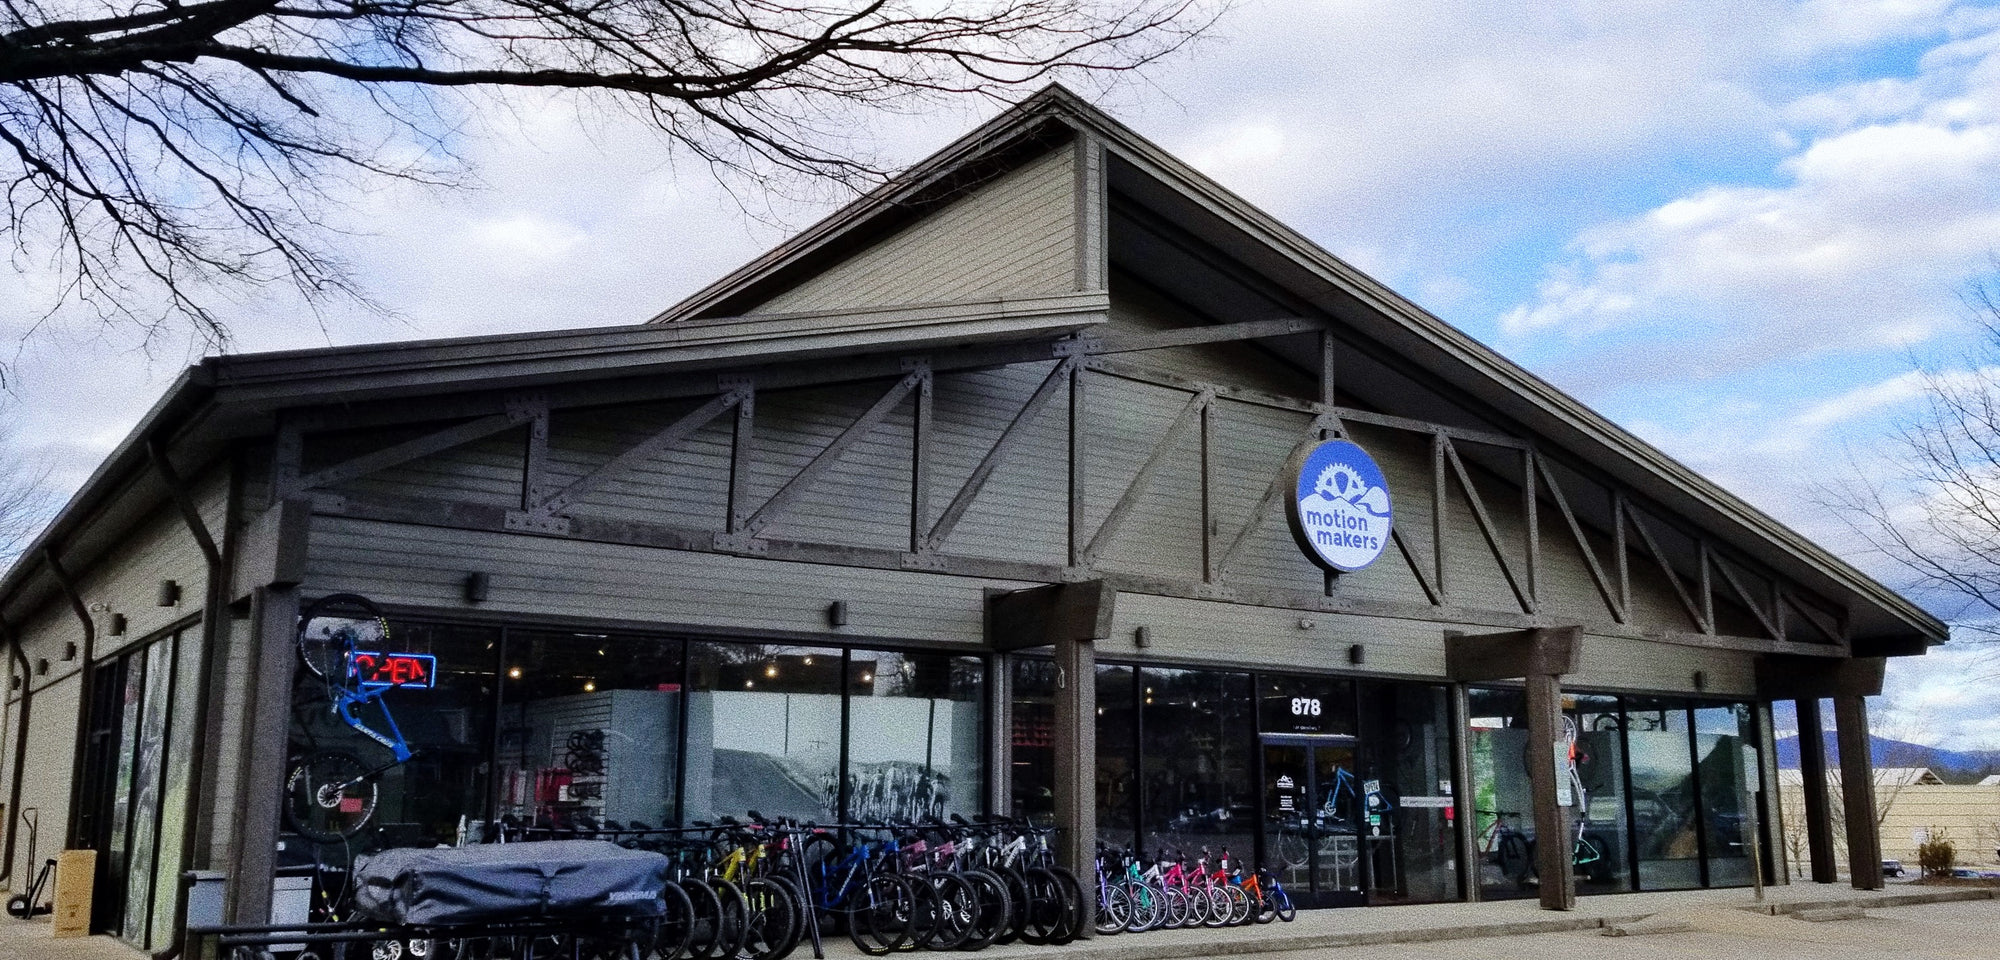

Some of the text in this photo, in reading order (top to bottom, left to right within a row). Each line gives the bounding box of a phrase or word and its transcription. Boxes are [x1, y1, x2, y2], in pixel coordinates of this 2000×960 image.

[1306, 509, 1368, 531] motion
[1317, 530, 1378, 550] makers
[1291, 697, 1321, 716] 878
